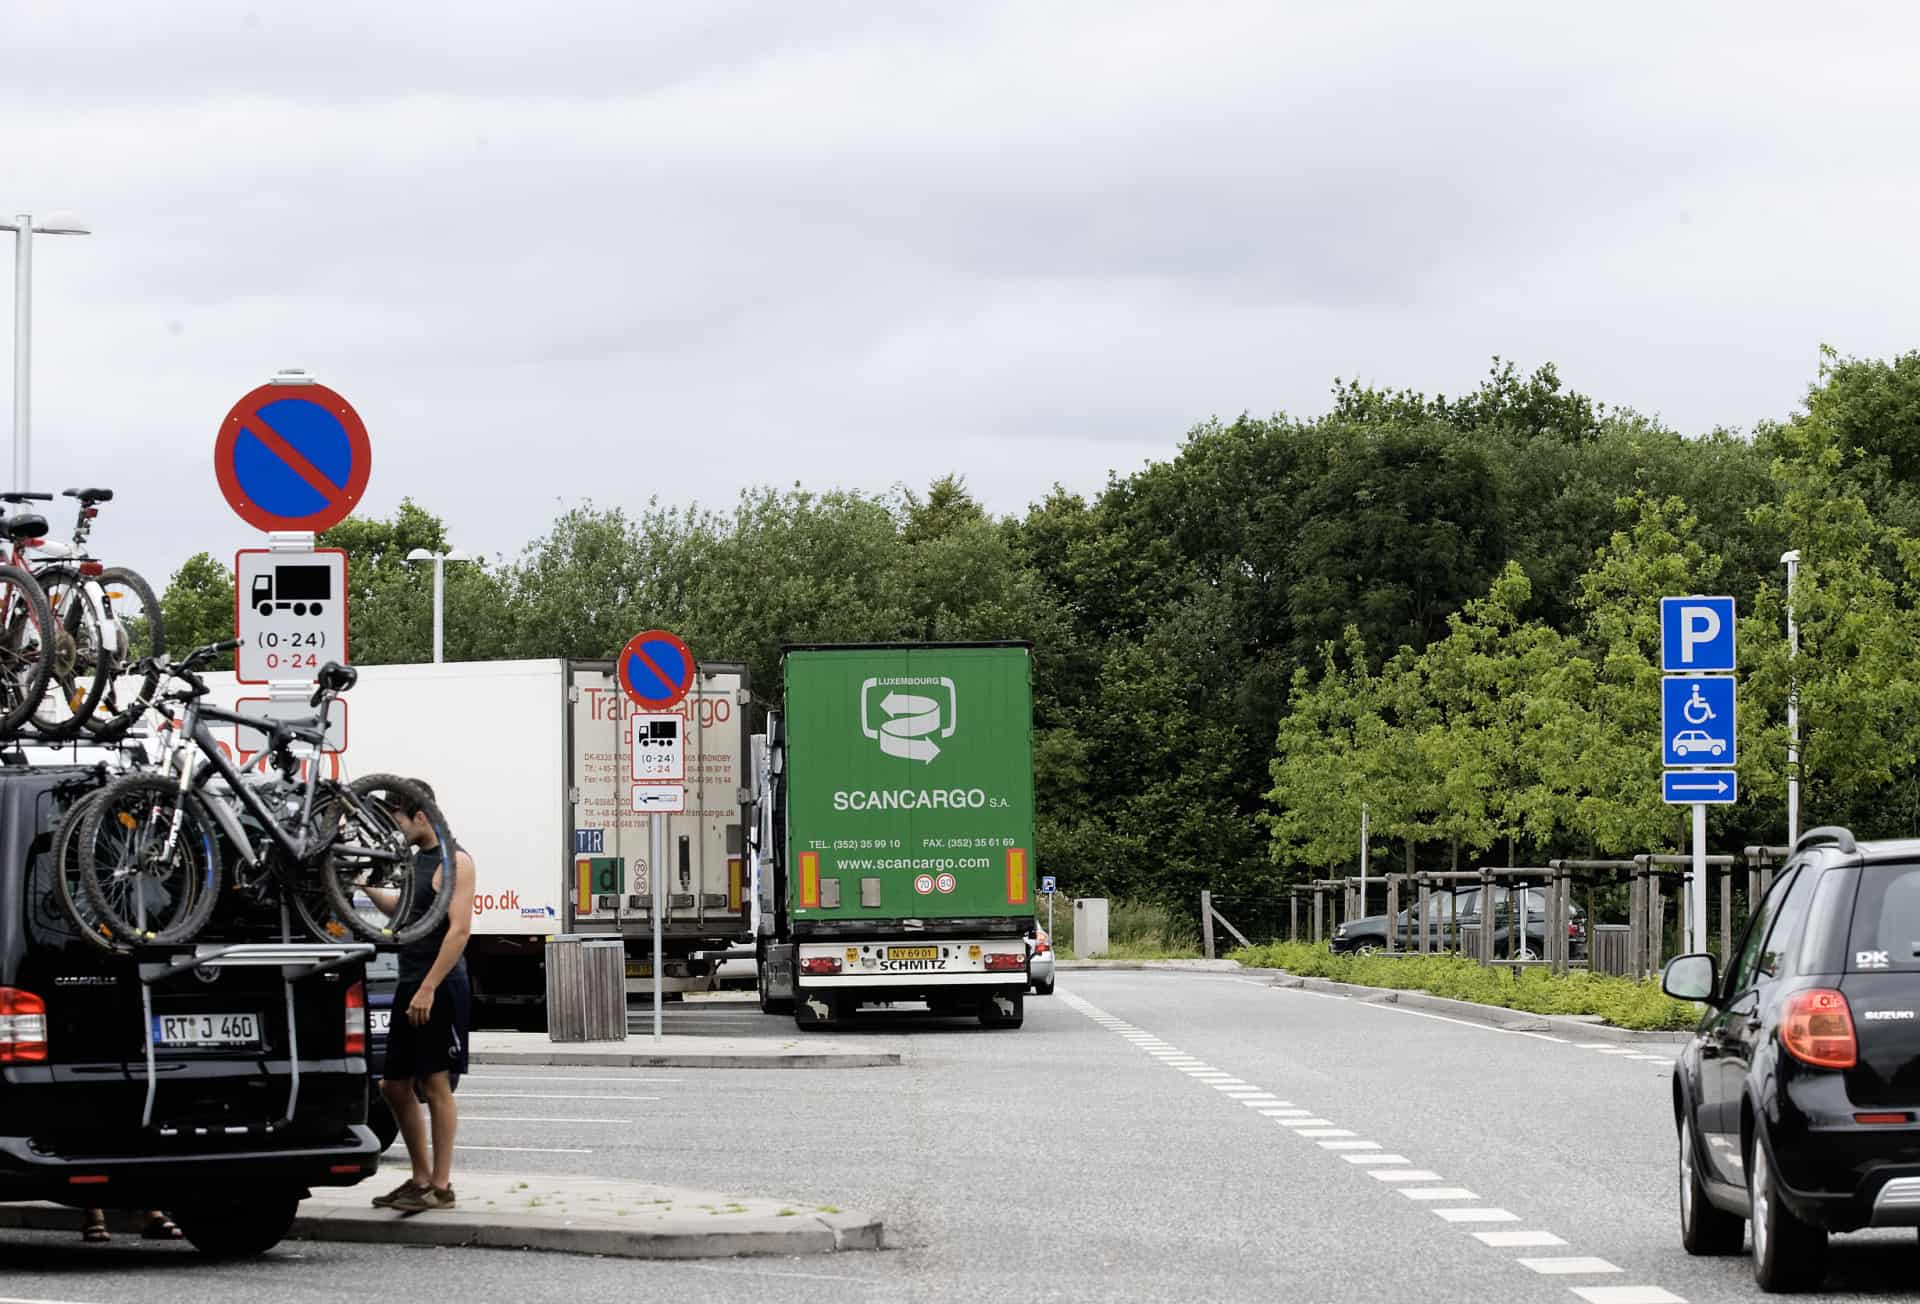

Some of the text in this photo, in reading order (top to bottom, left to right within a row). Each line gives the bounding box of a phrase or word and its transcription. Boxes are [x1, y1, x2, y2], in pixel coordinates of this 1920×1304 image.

[258, 632, 325, 648] (0-24)
[1680, 606, 1721, 663] P
[266, 654, 318, 669] 0-24
[878, 676, 940, 686] LUXEMBOURG
[584, 688, 731, 729] Tranargo
[641, 754, 675, 764] (0-24)
[833, 788, 1011, 811] SCANCARGO S.A.
[577, 831, 602, 852] TIR
[808, 840, 831, 849] TEL.
[833, 839, 858, 851] (352)
[860, 839, 873, 849] 35
[890, 839, 901, 849] 10
[922, 839, 945, 848] FAX.
[947, 838, 973, 849] (352)
[974, 838, 987, 847] 35
[988, 838, 1000, 847] 61
[836, 856, 990, 872] www.scancargo.com
[1855, 951, 1889, 964] DK
[879, 960, 947, 971] SCHMITZ
[1864, 1010, 1915, 1020] SUZUKI
[164, 1016, 252, 1040] RT J 460
